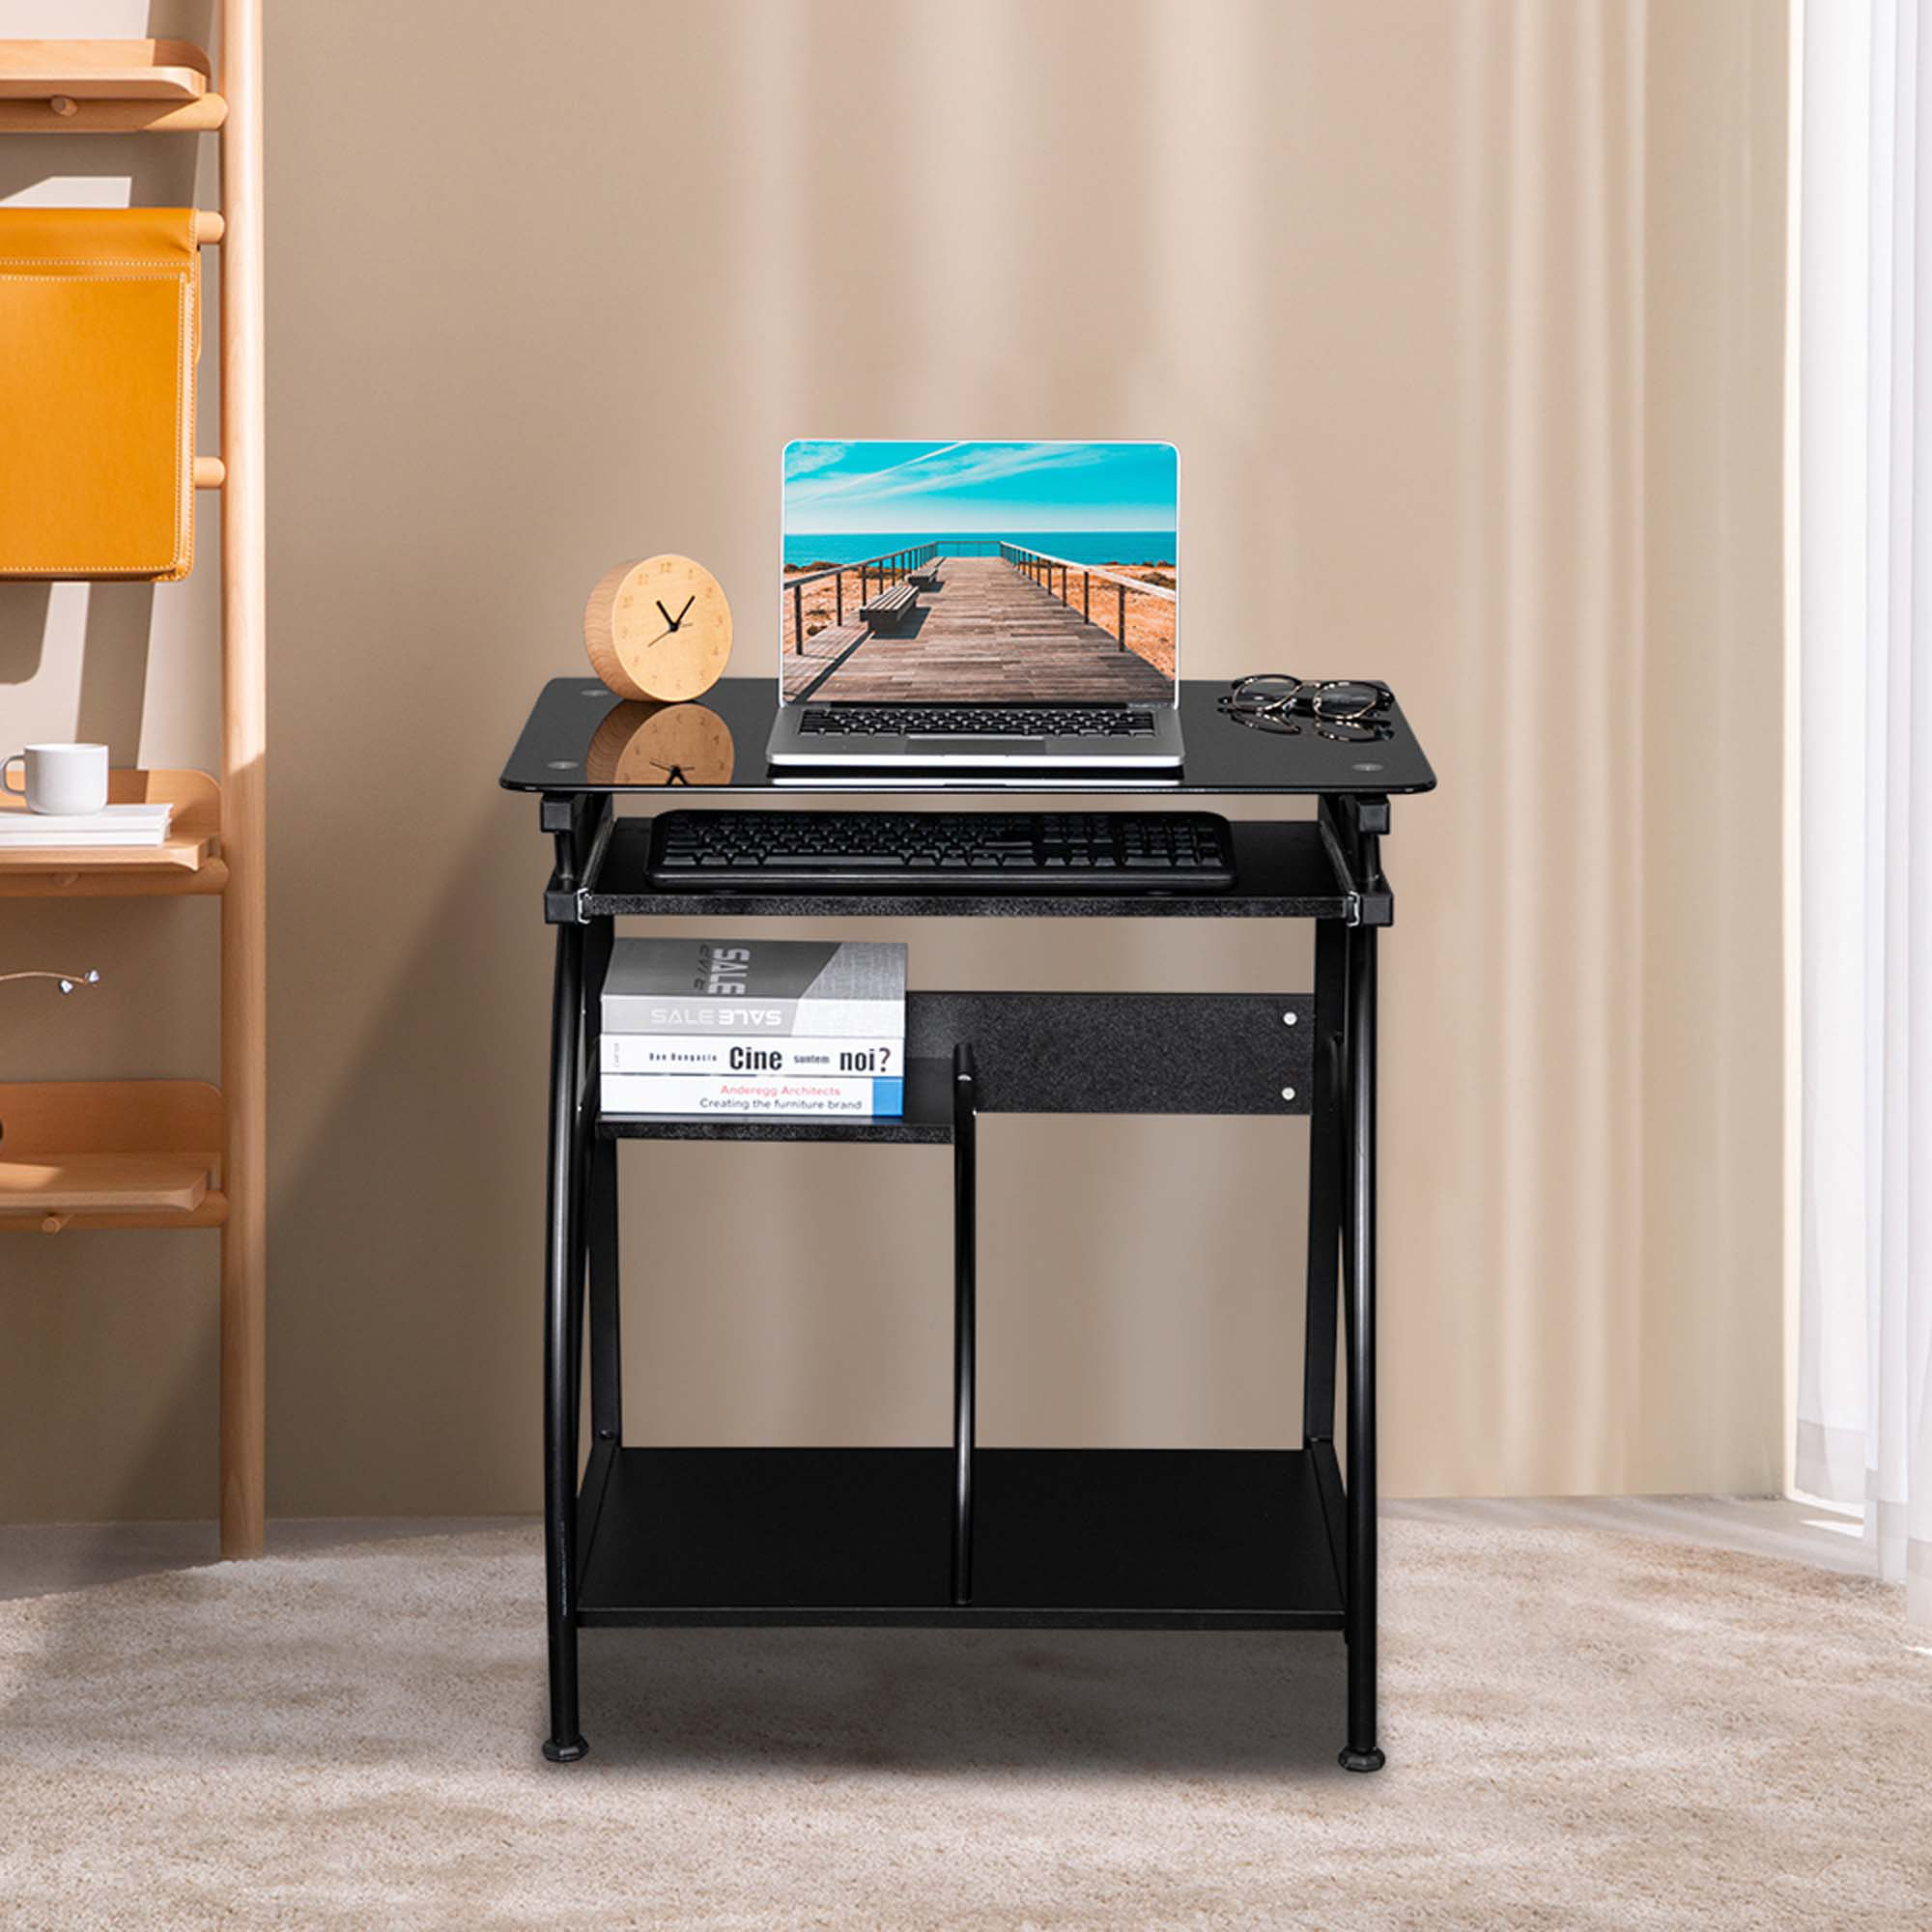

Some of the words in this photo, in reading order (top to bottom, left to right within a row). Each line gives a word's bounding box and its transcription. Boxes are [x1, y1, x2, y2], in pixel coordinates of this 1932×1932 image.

[708, 947, 751, 995] SALE
[651, 1008, 715, 1025] SALE
[718, 1009, 782, 1026] SALE
[729, 1045, 782, 1071] Cine
[839, 1047, 892, 1072] noi?
[721, 1085, 778, 1096] Anderegg
[781, 1086, 841, 1096] Architects
[699, 1096, 751, 1110] Creating
[753, 1098, 771, 1109] the
[774, 1098, 825, 1110] furniture
[828, 1099, 863, 1110] brand
